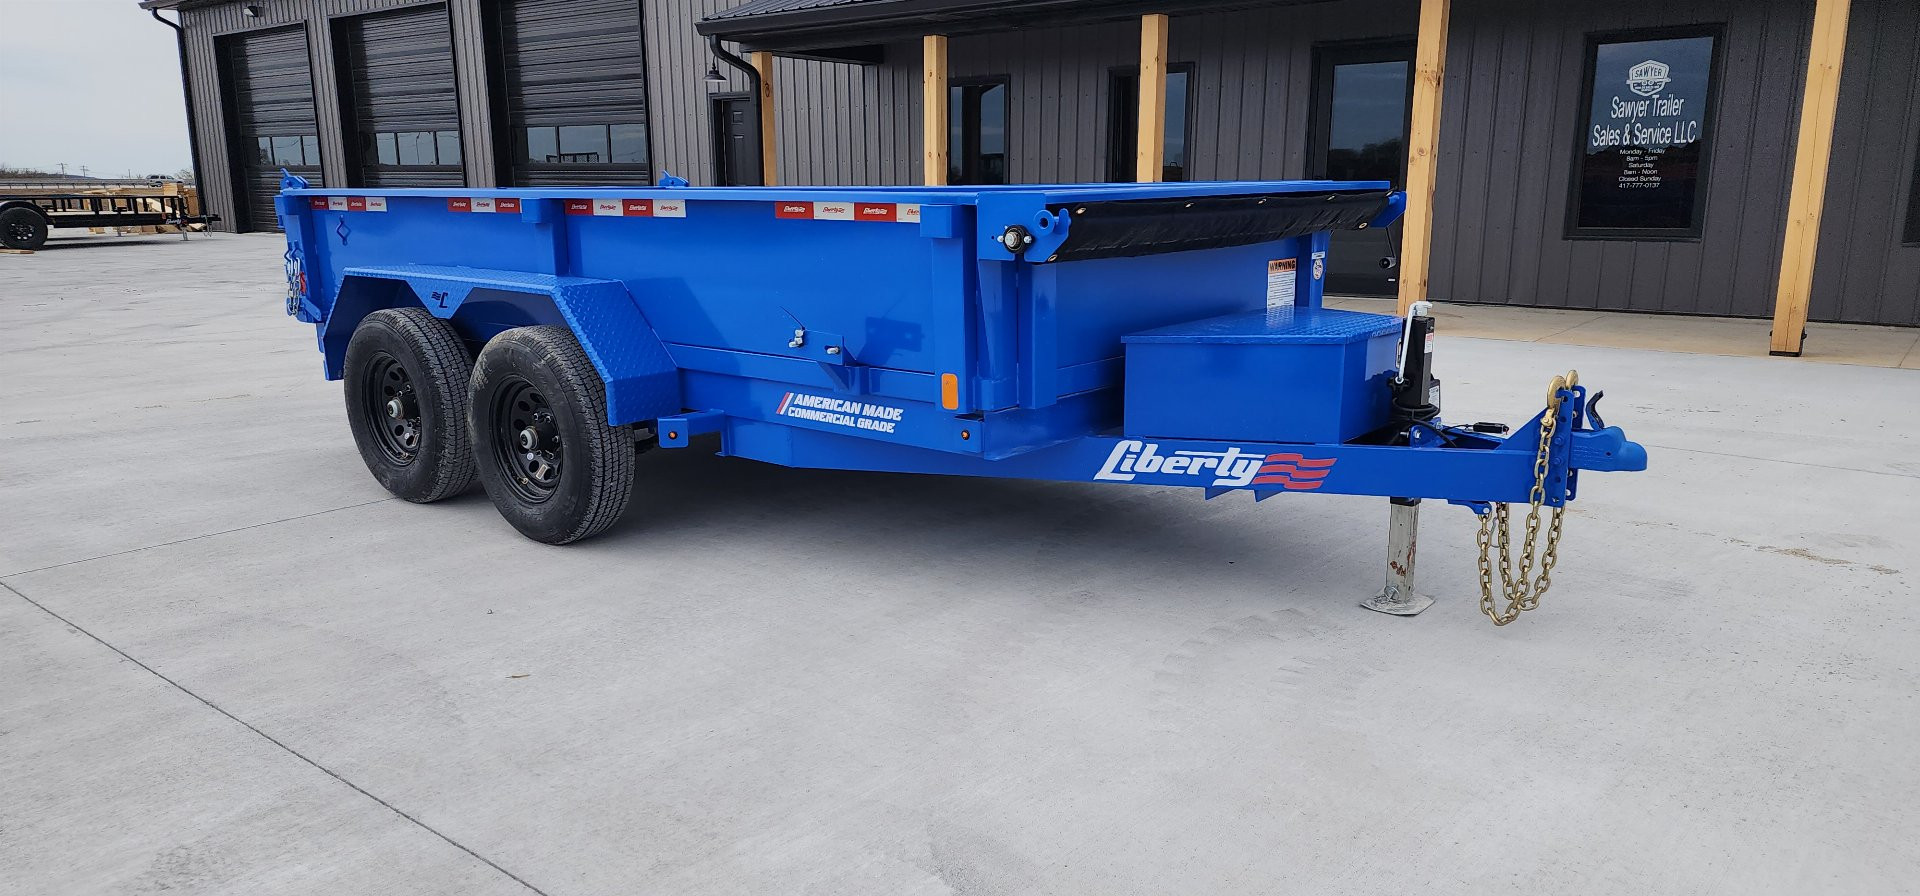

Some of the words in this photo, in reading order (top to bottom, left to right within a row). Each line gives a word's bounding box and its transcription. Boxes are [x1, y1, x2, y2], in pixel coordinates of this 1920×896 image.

[1635, 66, 1662, 77] SAWYER
[1611, 96, 1649, 123] Sawyer
[1651, 94, 1684, 117] Trailer
[1592, 124, 1620, 146] Sales
[1622, 123, 1631, 145] &
[1633, 122, 1672, 145] Service
[1673, 120, 1697, 144] LLC
[1269, 260, 1296, 272] WARNING
[787, 406, 856, 427] COMMERCIAL
[856, 417, 896, 434] GRADE
[793, 394, 862, 415] AMERICAN
[863, 402, 904, 421] MADE
[1093, 440, 1267, 487] Liberty
